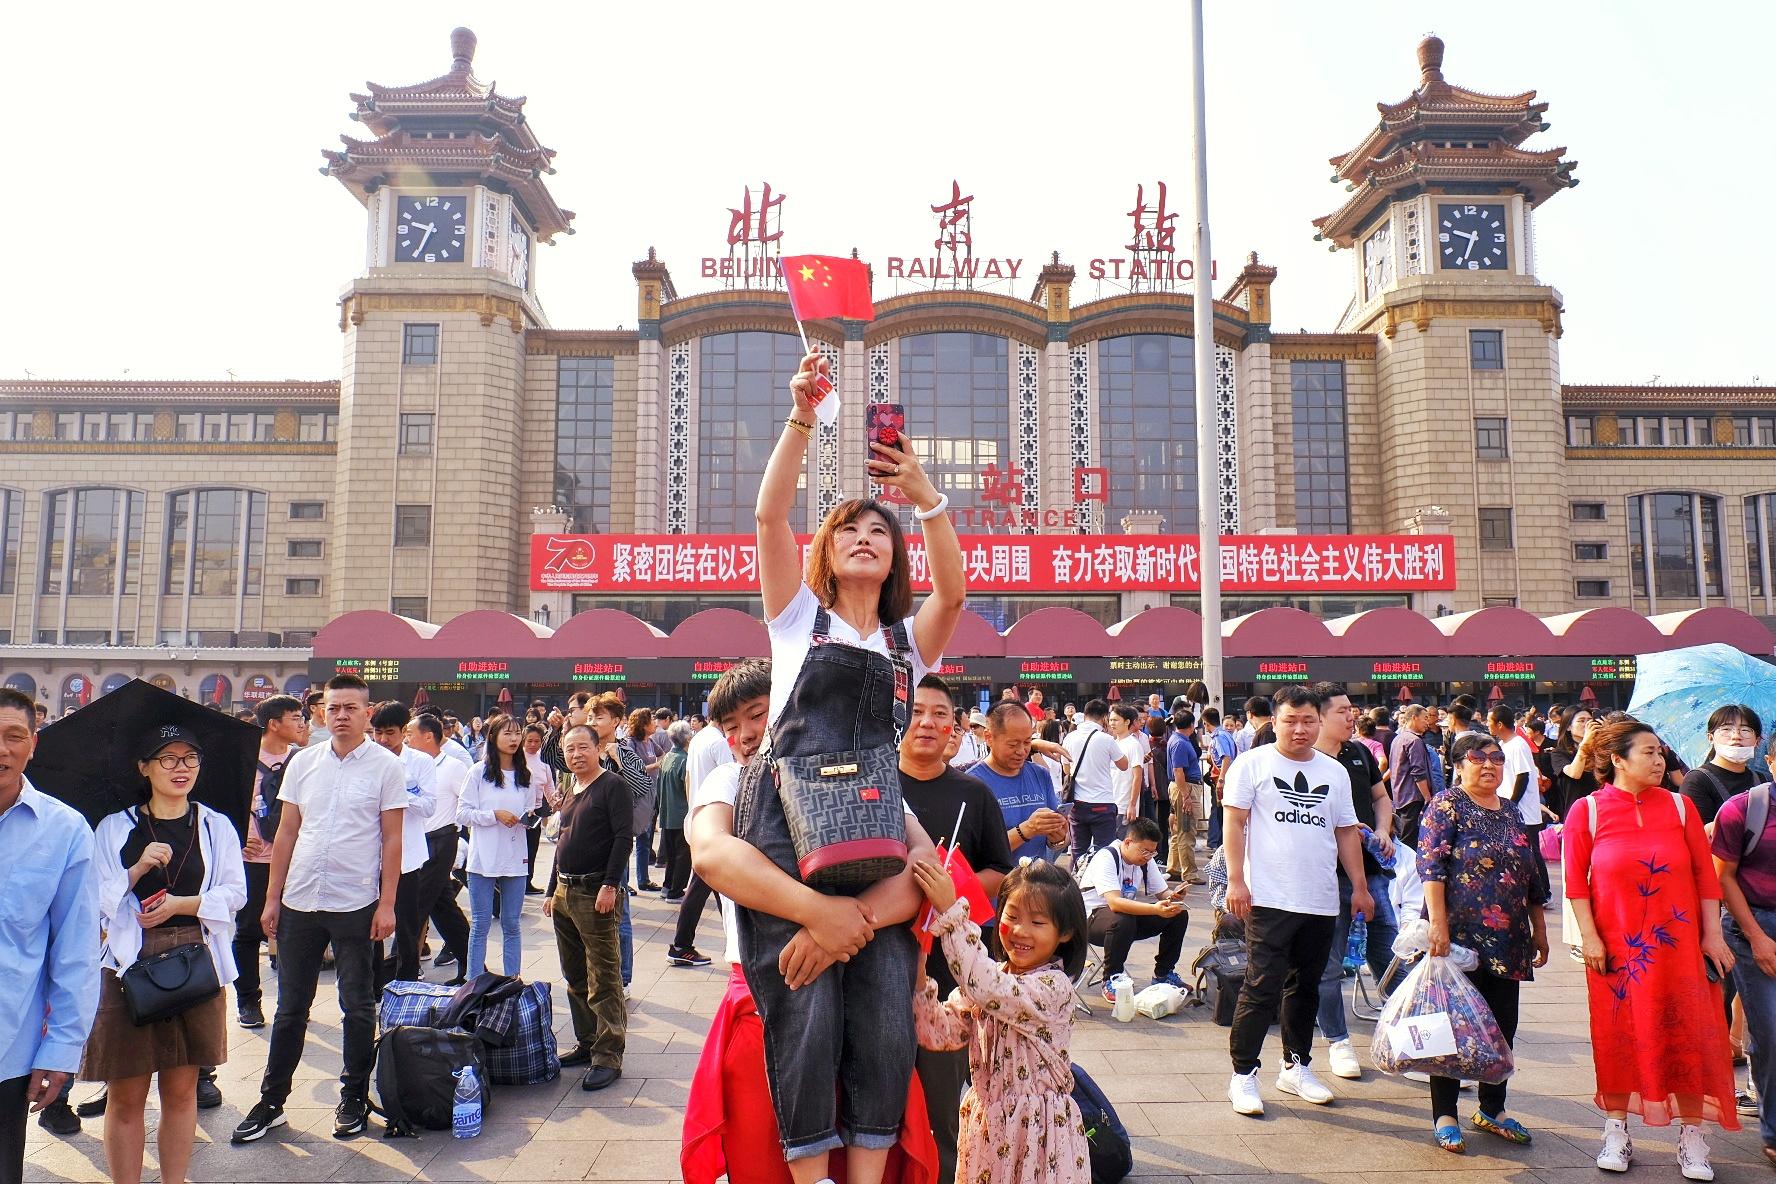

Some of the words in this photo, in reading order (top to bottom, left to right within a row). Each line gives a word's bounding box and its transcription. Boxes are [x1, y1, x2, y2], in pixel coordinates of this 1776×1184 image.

[426, 197, 439, 207] 12
[1464, 206, 1477, 215] 12
[397, 225, 409, 235] 9
[454, 225, 466, 235] 3
[1439, 233, 1450, 243] 9
[1493, 233, 1506, 243] 3
[424, 253, 436, 263] 6
[702, 256, 784, 278] BEIJIN
[887, 257, 1023, 278] RAILWAY
[1467, 260, 1480, 270] 6
[950, 510, 1078, 528] TRANCE
[1052, 543, 1443, 583] 奋力夺取新时代国特色社会主义伟大胜利
[458, 661, 507, 672] 自助进站口
[574, 663, 623, 673] 自助进站口
[694, 661, 737, 672] 自助进站
[1021, 662, 1069, 672] 自助进站口
[1259, 662, 1307, 672] 自助进站口
[1373, 662, 1420, 672] 自助进站口
[1487, 662, 1534, 672] 自助进站口
[1274, 809, 1326, 828] adidas
